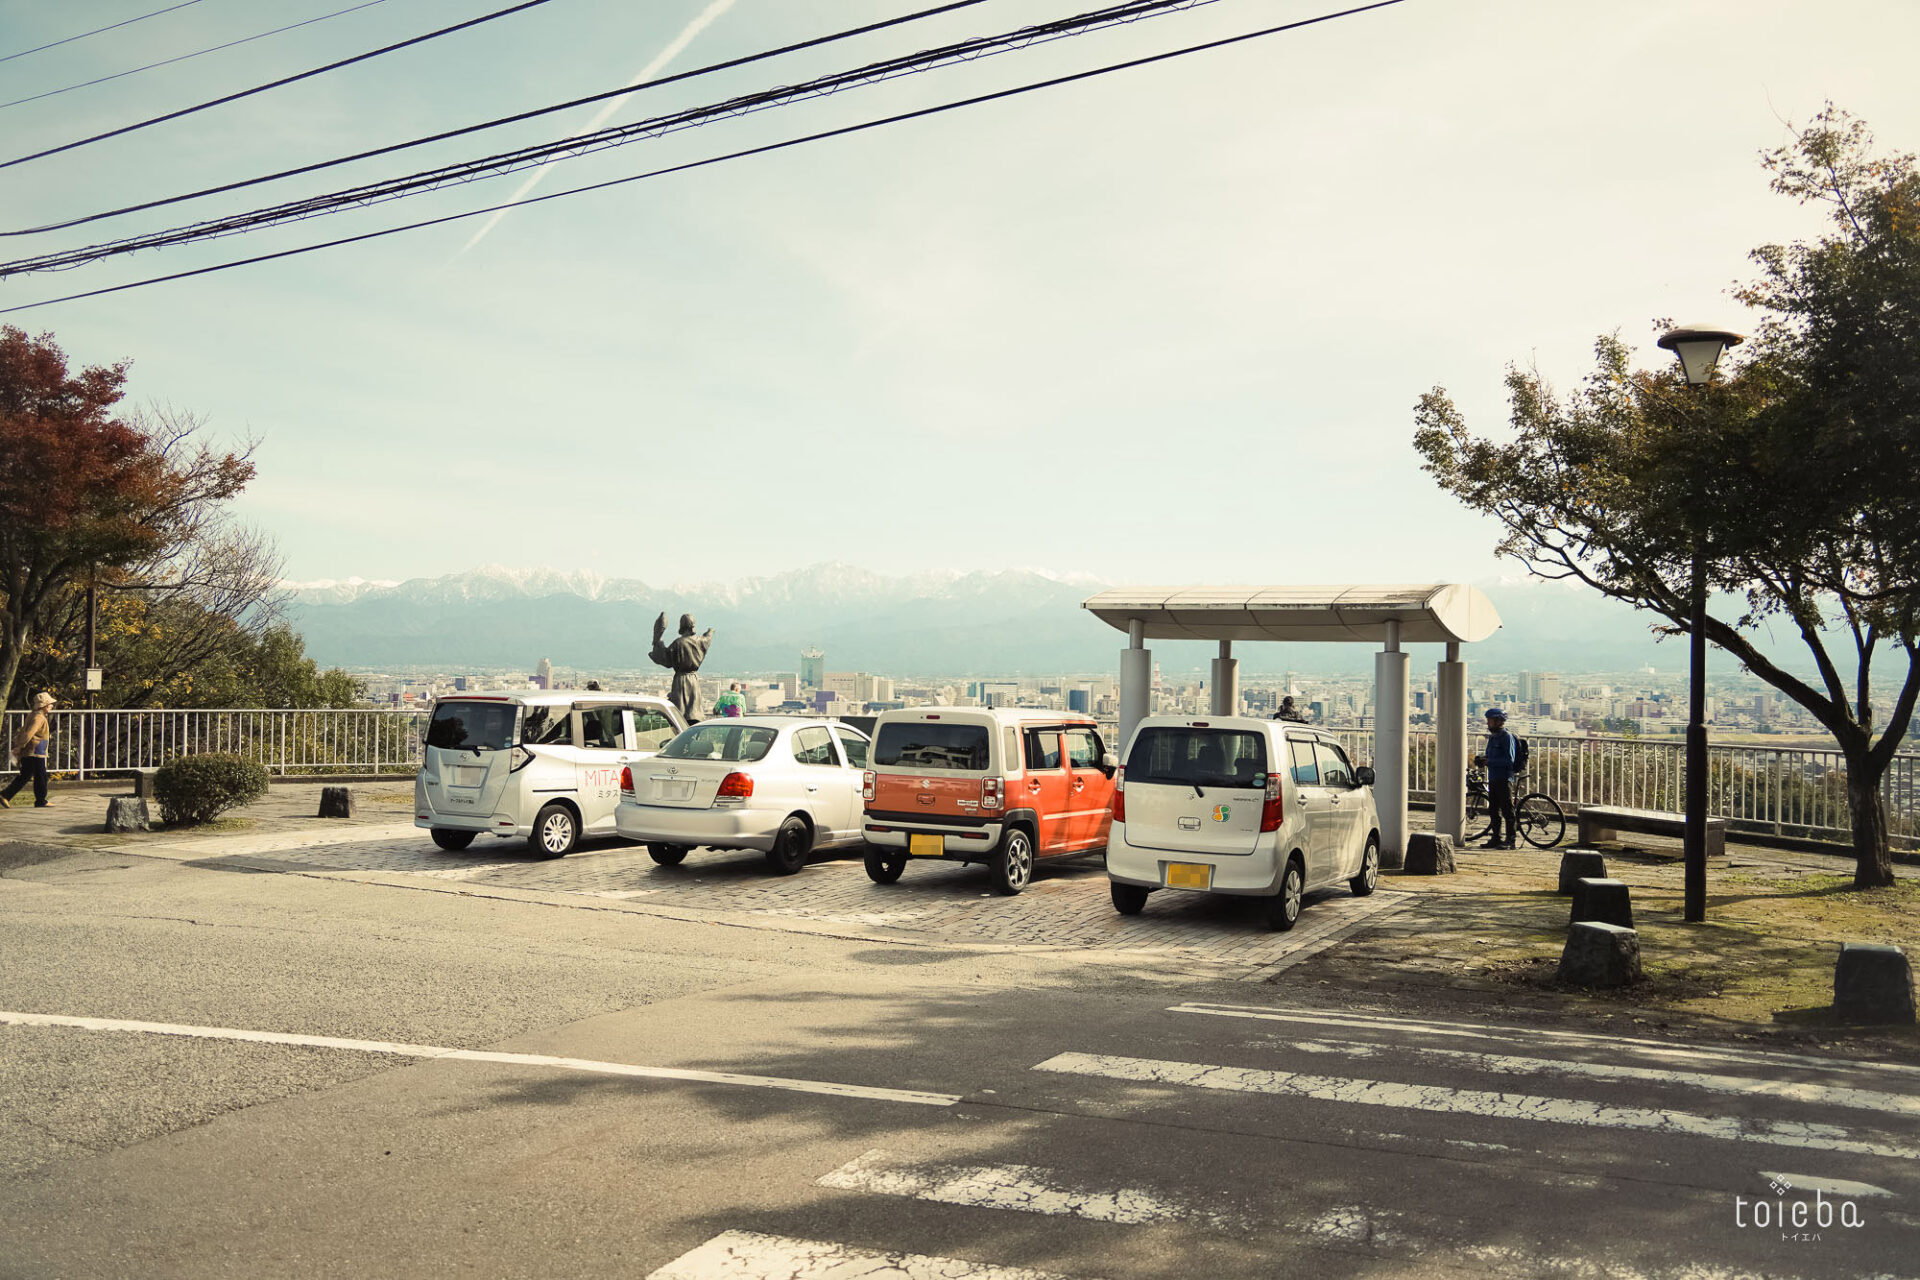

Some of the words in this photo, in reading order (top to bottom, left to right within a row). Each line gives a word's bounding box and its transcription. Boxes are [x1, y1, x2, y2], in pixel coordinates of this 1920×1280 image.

[585, 769, 622, 786] MITA
[598, 790, 619, 799] ミタス
